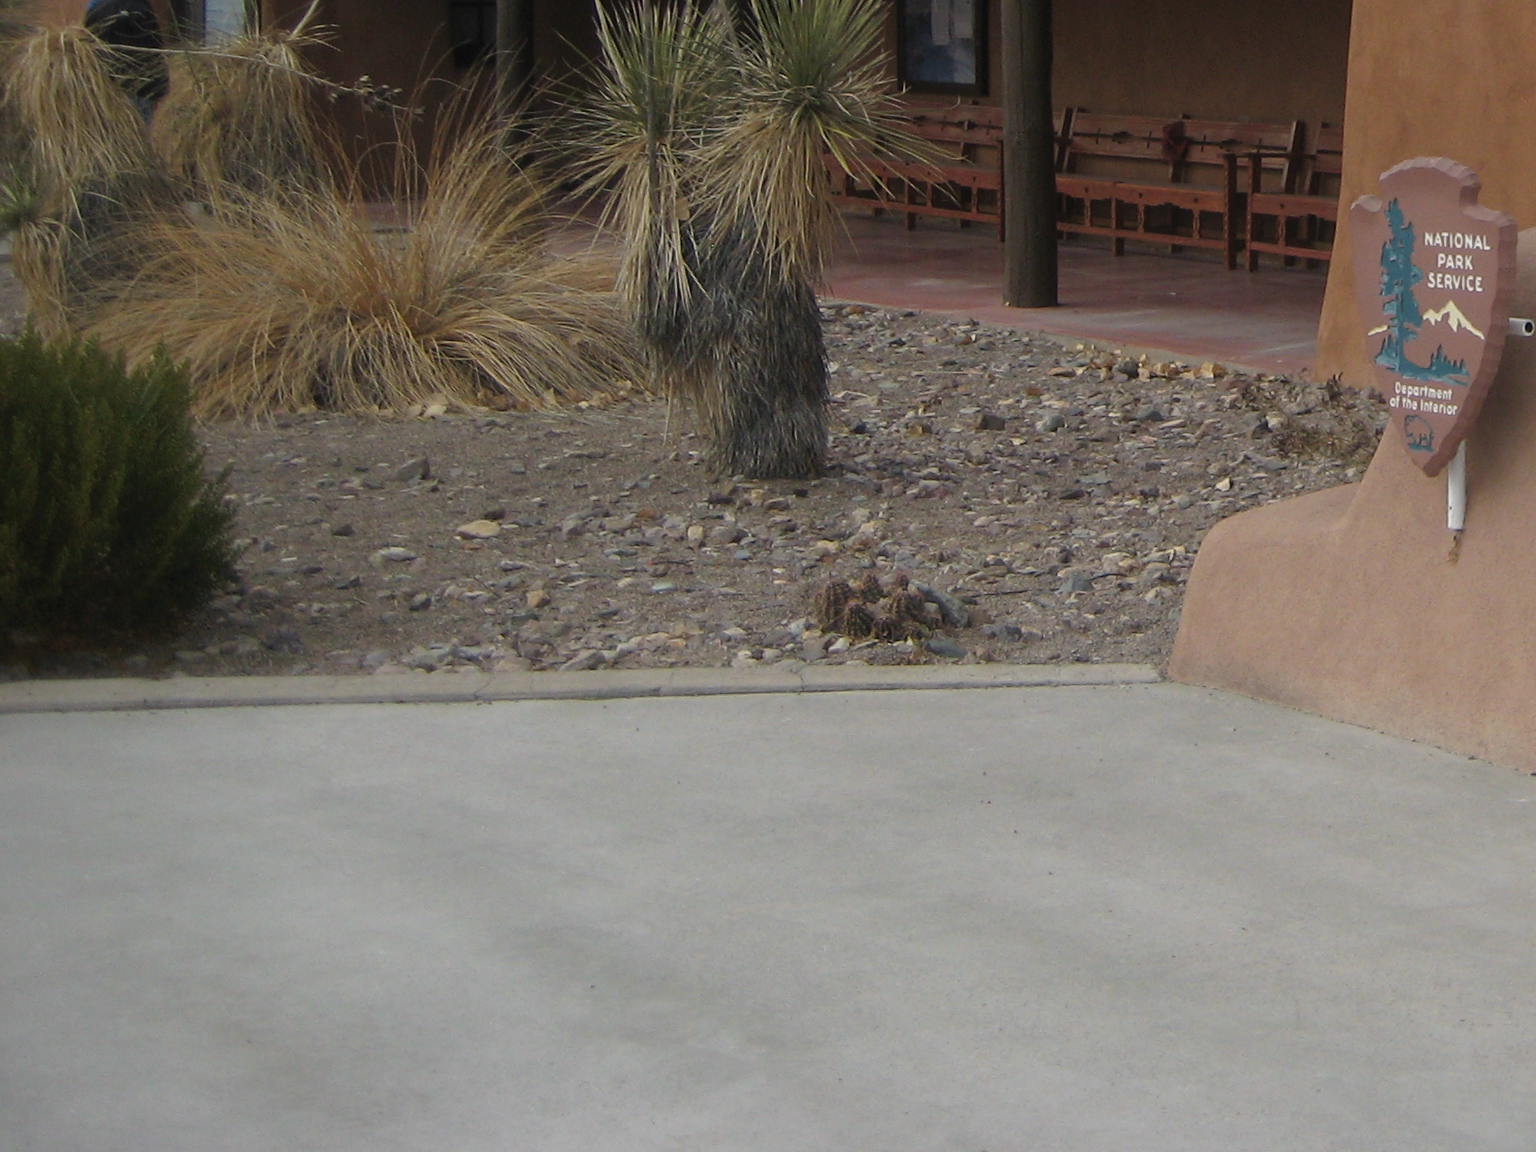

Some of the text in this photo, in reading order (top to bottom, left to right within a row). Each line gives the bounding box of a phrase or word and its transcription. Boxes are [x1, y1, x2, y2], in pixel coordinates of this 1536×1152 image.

[1424, 232, 1491, 250] NATIONAL
[1437, 253, 1473, 270] PARK
[1427, 272, 1483, 292] SERVICE
[1395, 381, 1452, 400] Department
[1389, 396, 1458, 416] of the Interior
